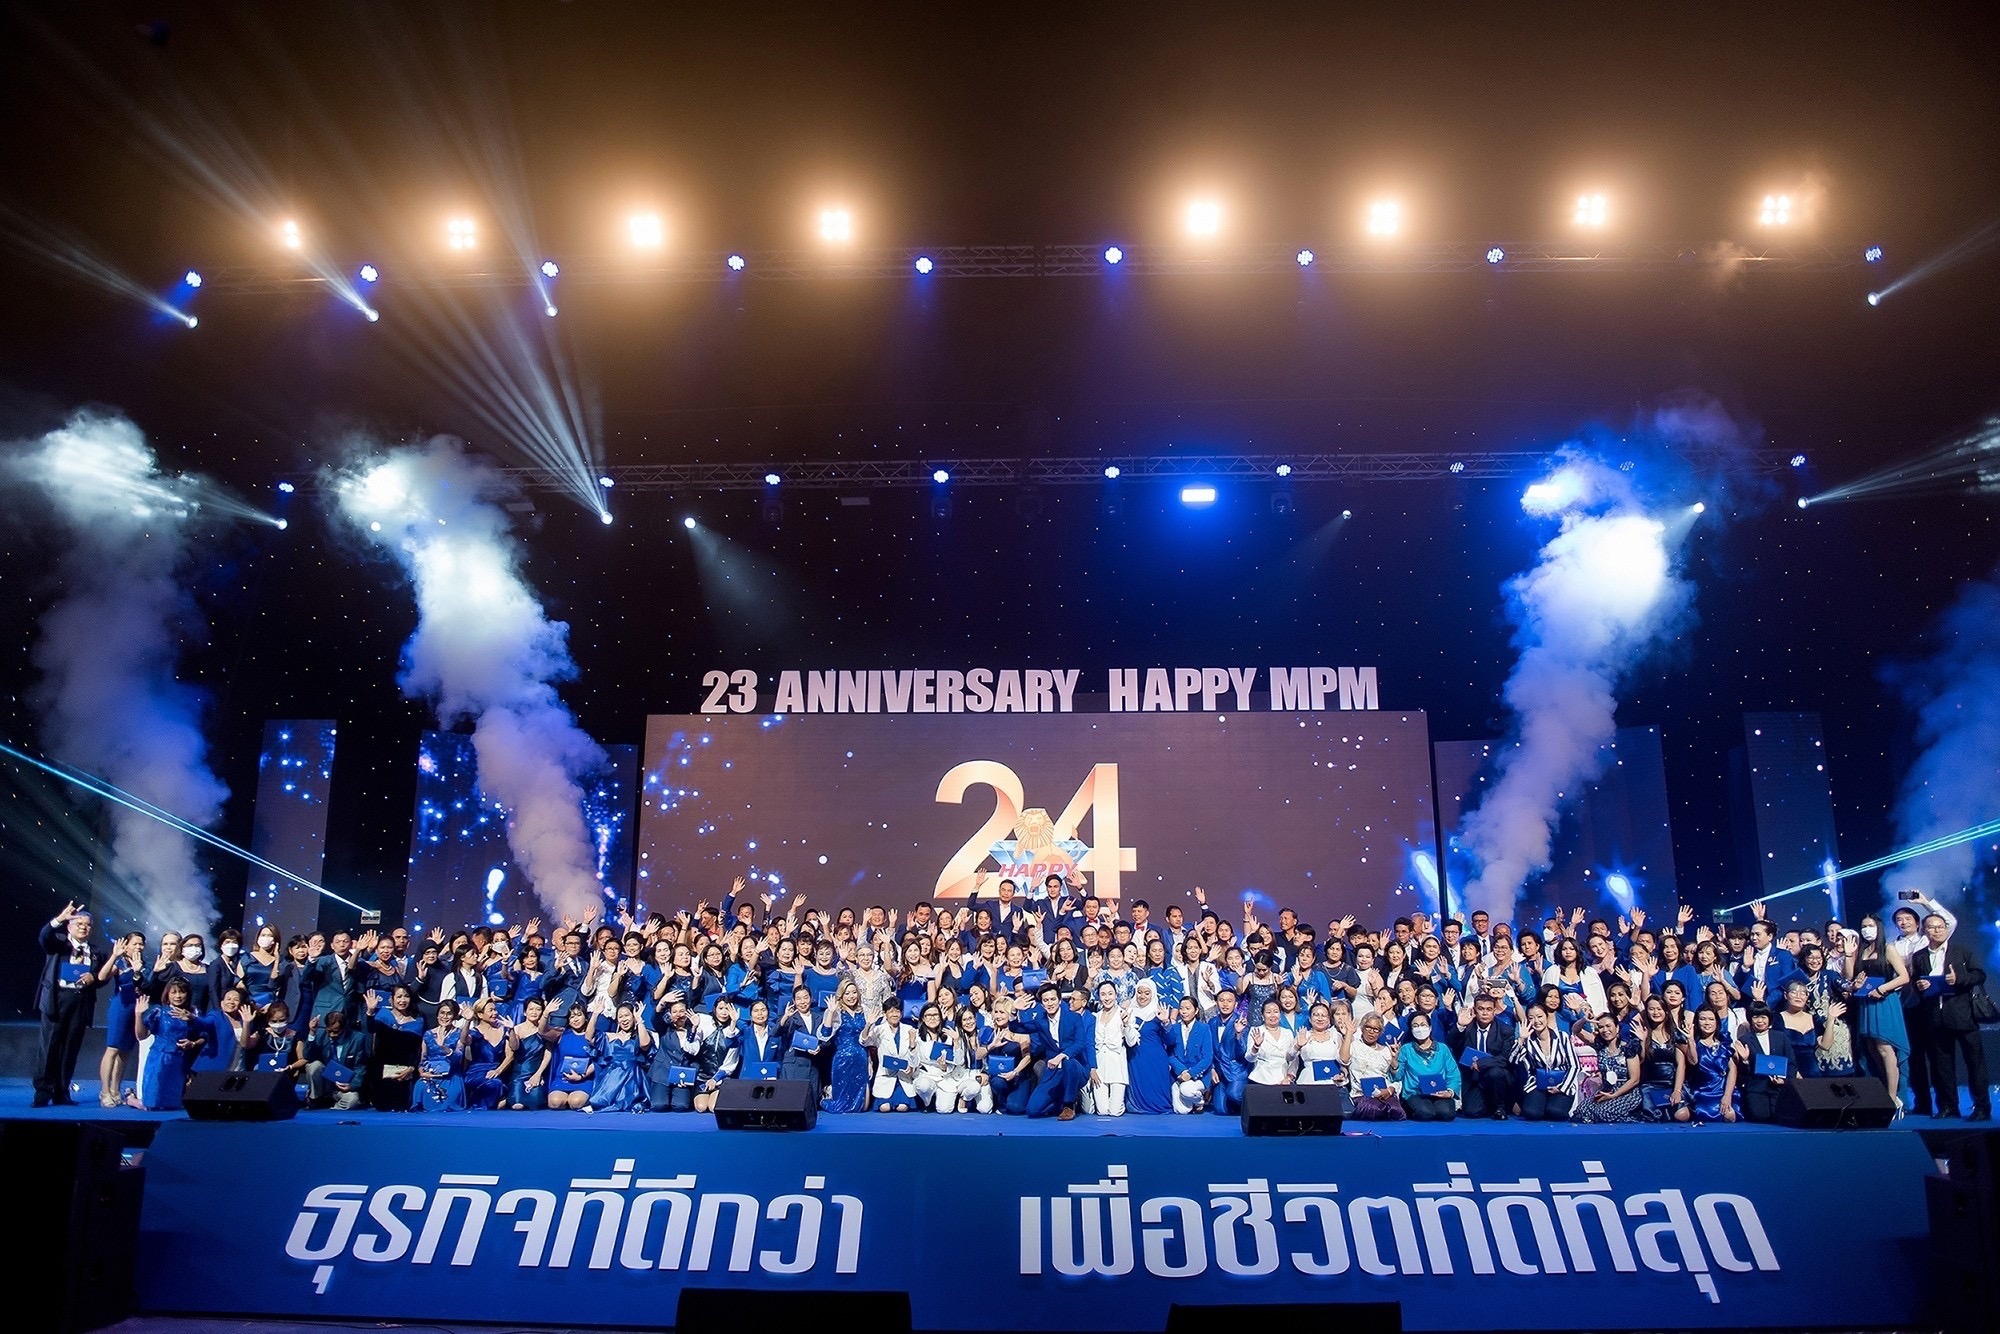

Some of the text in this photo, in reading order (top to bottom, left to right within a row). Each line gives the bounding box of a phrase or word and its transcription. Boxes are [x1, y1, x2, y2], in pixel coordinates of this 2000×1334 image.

[700, 666, 1380, 714] 23 ANNIVERSARY HAPPY MPM
[934, 760, 1137, 899] 24
[998, 863, 1079, 878] HAPPY
[285, 1157, 1782, 1305] ธุรกิจที่ดีกว่า เพื่อชีวิตที่ดีที่สุด
